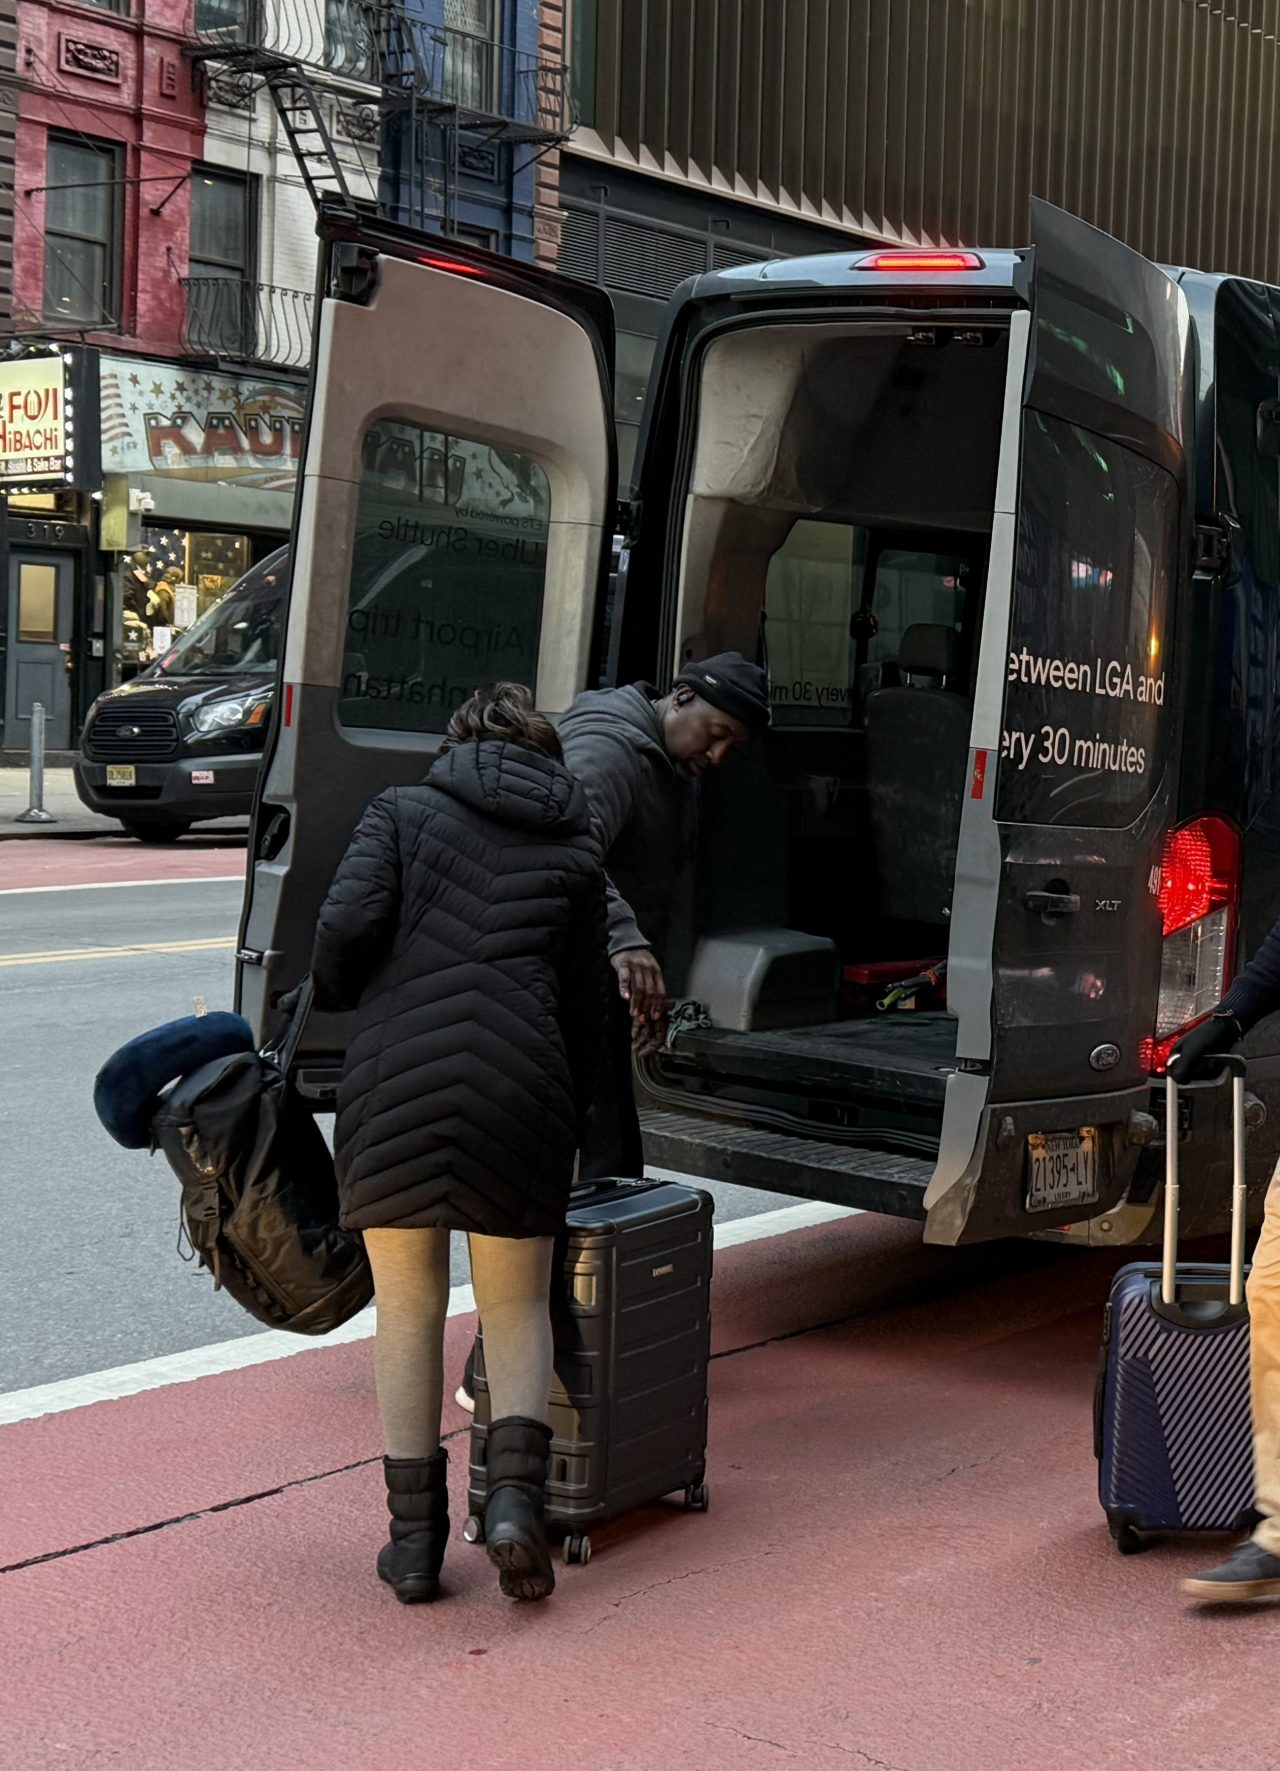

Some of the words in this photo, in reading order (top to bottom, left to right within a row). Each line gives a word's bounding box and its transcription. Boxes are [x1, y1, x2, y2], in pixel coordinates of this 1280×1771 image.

[27, 522, 64, 539] 319
[1096, 658, 1133, 700] LGA
[1137, 672, 1165, 706] and
[1038, 726, 1070, 765] 30
[1073, 733, 1146, 774] minutes
[1095, 900, 1122, 911] XLT
